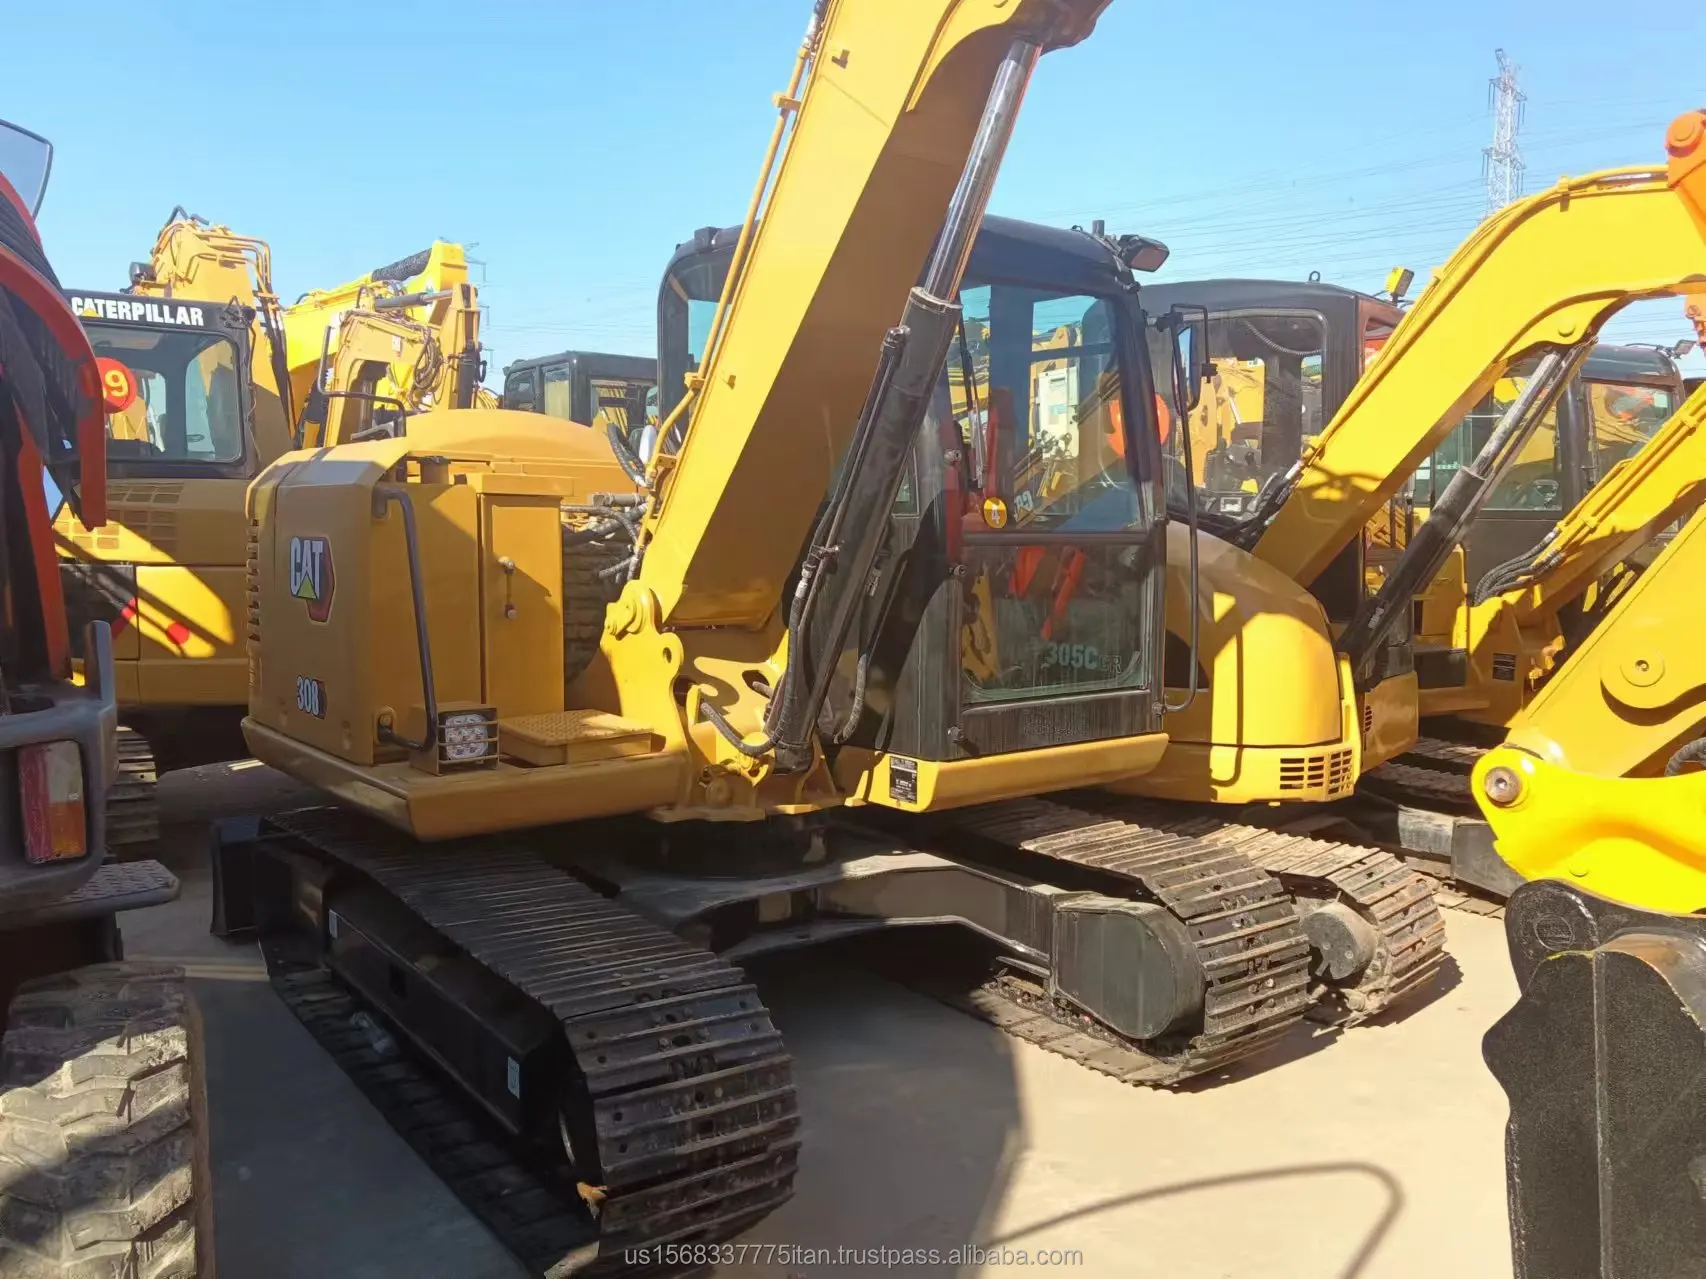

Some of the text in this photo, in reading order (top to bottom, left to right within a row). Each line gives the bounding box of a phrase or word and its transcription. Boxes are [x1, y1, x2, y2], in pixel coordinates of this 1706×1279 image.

[71, 297, 204, 326] CATERPILLAR
[103, 370, 129, 399] 9
[291, 537, 323, 599] CAT
[296, 675, 320, 715] 308
